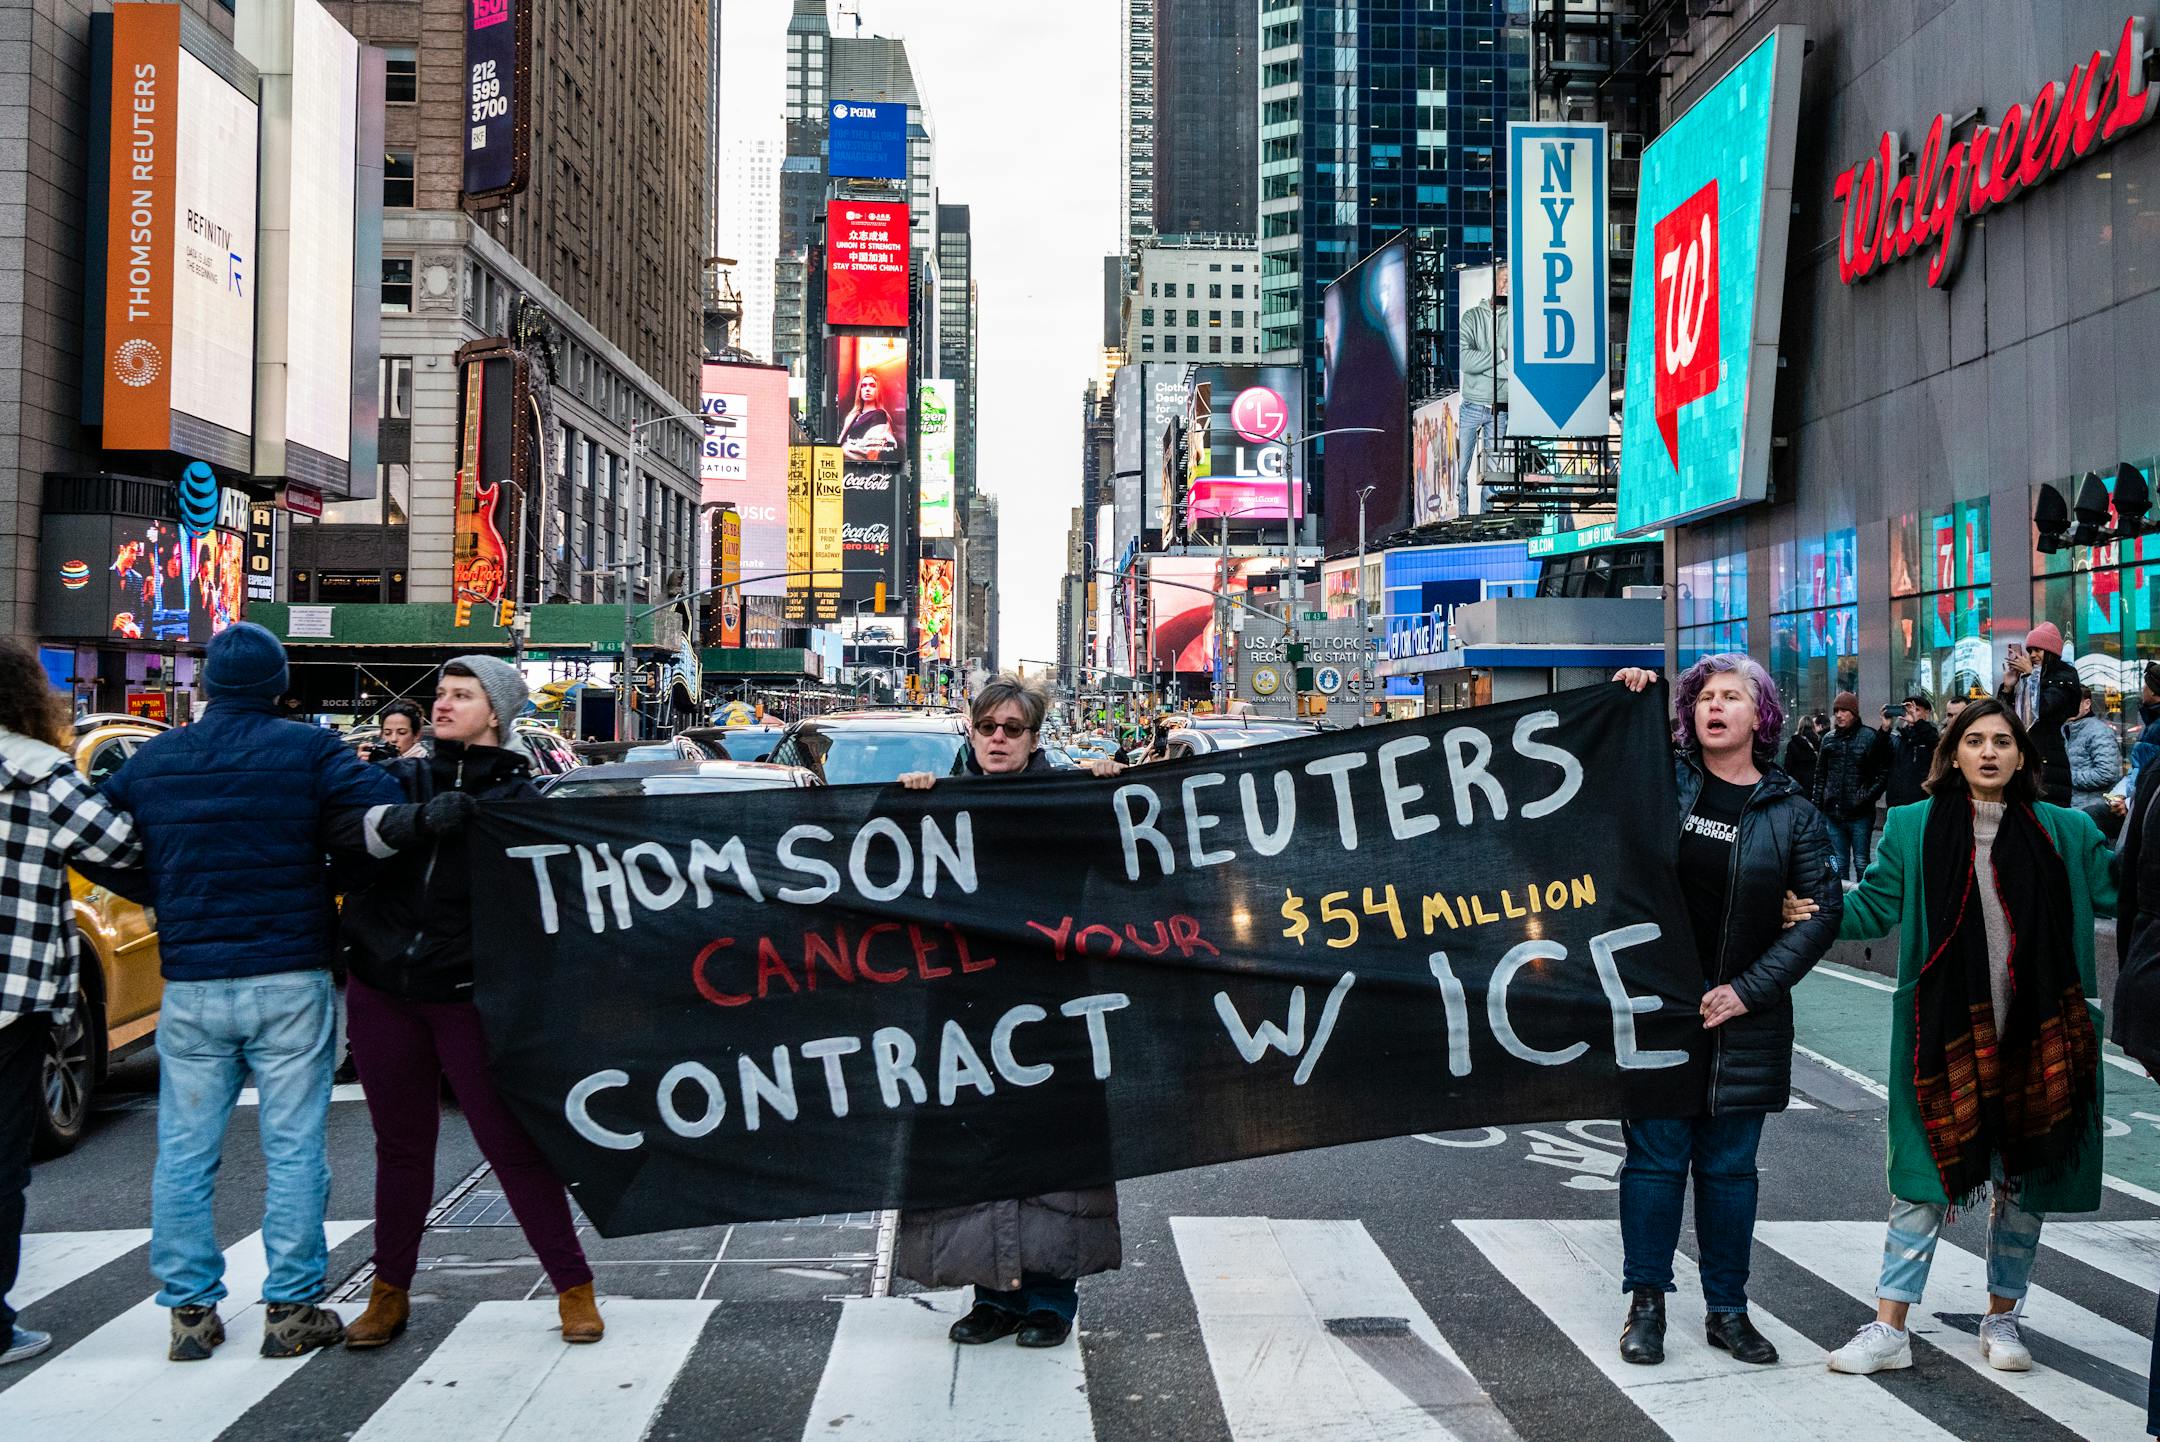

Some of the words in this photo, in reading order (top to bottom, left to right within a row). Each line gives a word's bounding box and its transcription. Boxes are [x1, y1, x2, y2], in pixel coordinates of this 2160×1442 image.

[472, 60, 496, 83] 212
[472, 78, 500, 102] 599
[471, 96, 508, 122] 3700
[849, 107, 877, 119] PGIM
[131, 63, 157, 182] REUTERS
[833, 139, 882, 151] INVESTMENT
[1834, 15, 2156, 288] Walgreens
[833, 150, 888, 163] MANAGEMENT
[187, 208, 231, 251] REFINITIV
[848, 230, 889, 241] 众志成城
[128, 189, 154, 322] THOMSON
[836, 241, 858, 249] UNION
[867, 242, 901, 251] STRENGTH
[1540, 142, 1576, 360] NYPD
[832, 262, 850, 270] STAY
[851, 262, 878, 271] STRONG
[879, 263, 903, 272] CHINA!
[1155, 405, 1171, 413] for
[1235, 446, 1284, 478] LG
[817, 468, 838, 481] LION
[842, 472, 892, 491] Coca-Cola
[816, 482, 841, 496] KING
[723, 519, 740, 538] BUBBA
[724, 538, 739, 556] GUMP
[455, 563, 479, 583] Hard
[478, 564, 503, 585] Rock
[1312, 612, 1321, 620] 43
[1244, 637, 1268, 649] U.S.
[1386, 620, 1400, 661] NEW
[1399, 619, 1413, 659] YORK
[1412, 615, 1430, 657] POLICE
[1430, 611, 1445, 654] DEPT
[321, 699, 349, 707] ROCK
[351, 699, 378, 707] SHOP
[506, 810, 978, 935] THOMSON
[1112, 710, 1584, 881] REUTERS
[1687, 815, 1731, 833] MANITY
[691, 921, 997, 1006] CANCEL
[1026, 915, 1220, 961] YOUR
[1281, 883, 1408, 949] $54
[1422, 873, 1597, 936] MILLION
[565, 992, 1130, 1150] CONTRACT
[1213, 970, 1356, 1086] W/
[1428, 922, 1690, 1077] ICE
